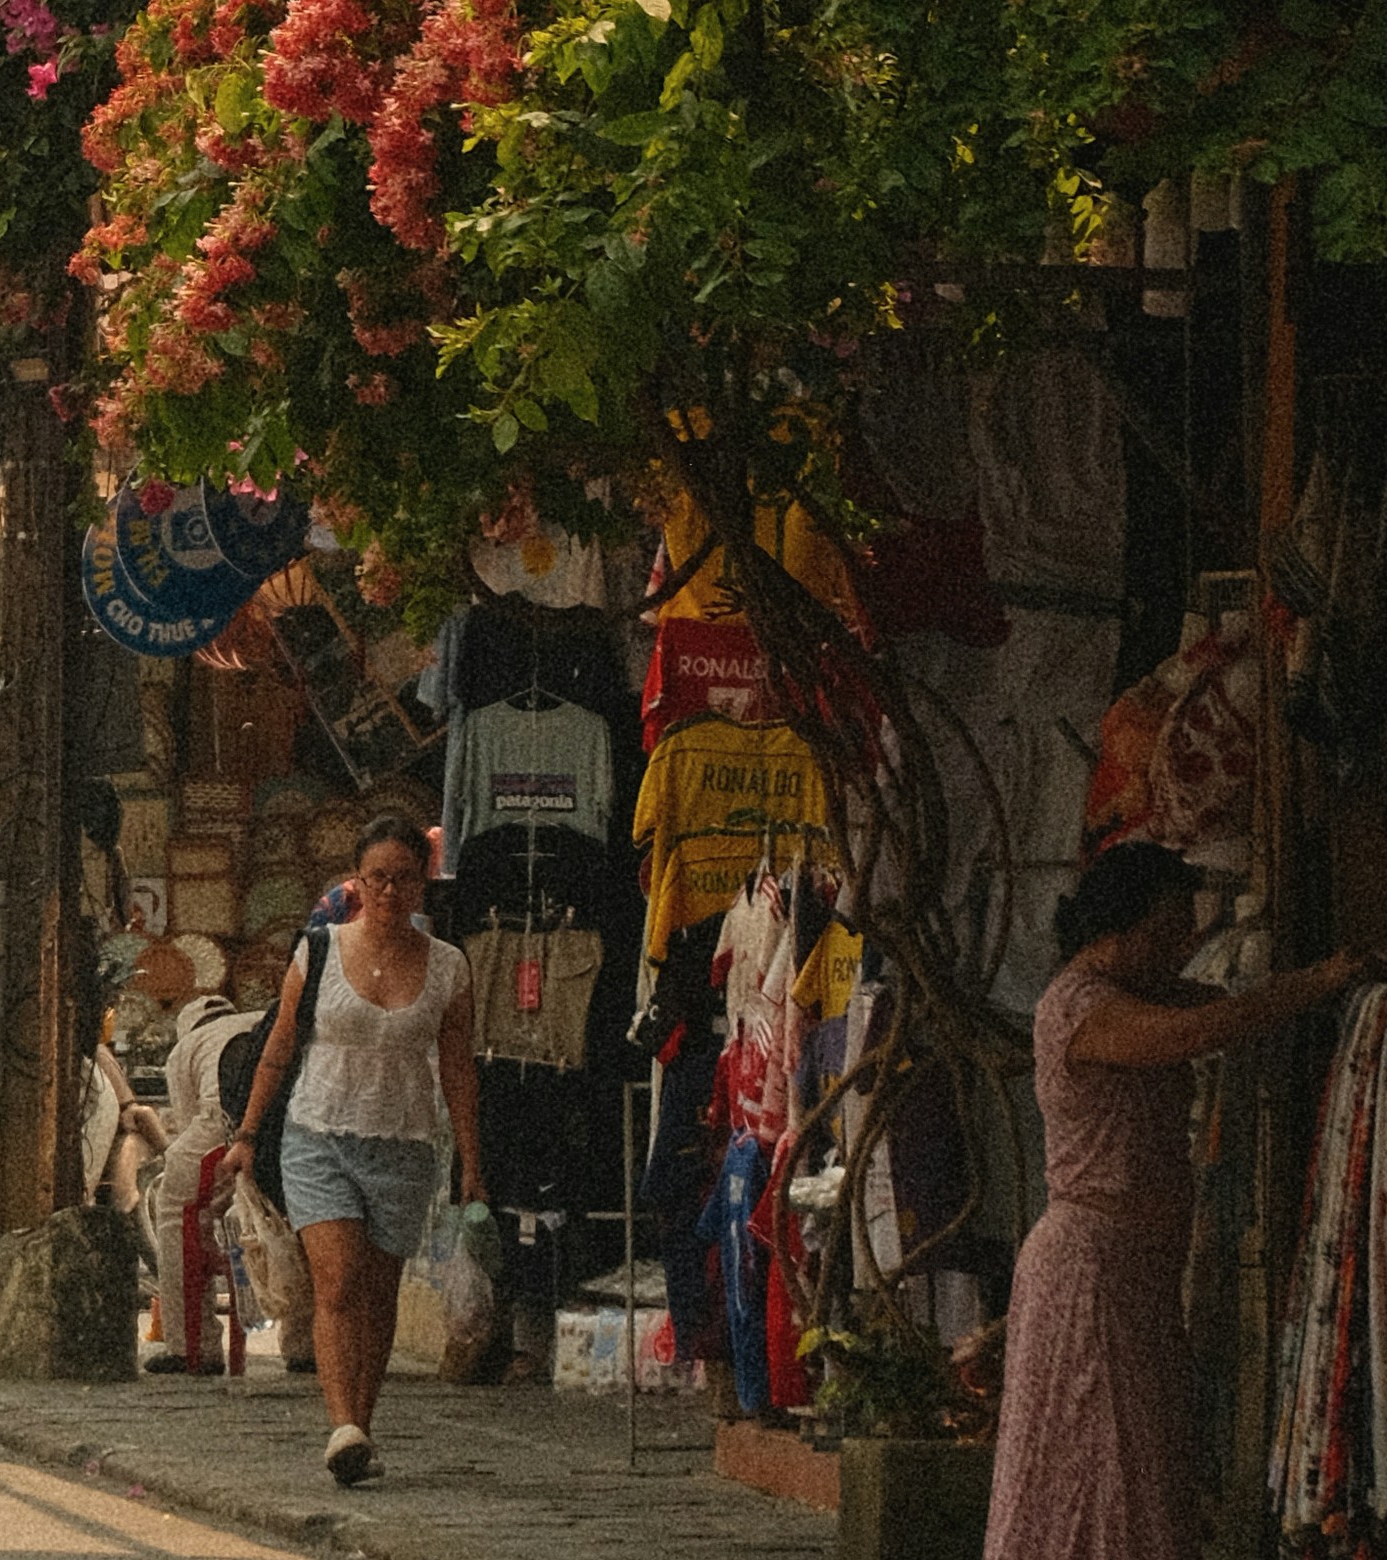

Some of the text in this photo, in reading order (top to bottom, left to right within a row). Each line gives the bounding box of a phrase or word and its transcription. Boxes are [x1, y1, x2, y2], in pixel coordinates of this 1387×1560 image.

[106, 598, 145, 636] CHO
[701, 764, 803, 799] RONALDO
[495, 794, 574, 811] patagonia
